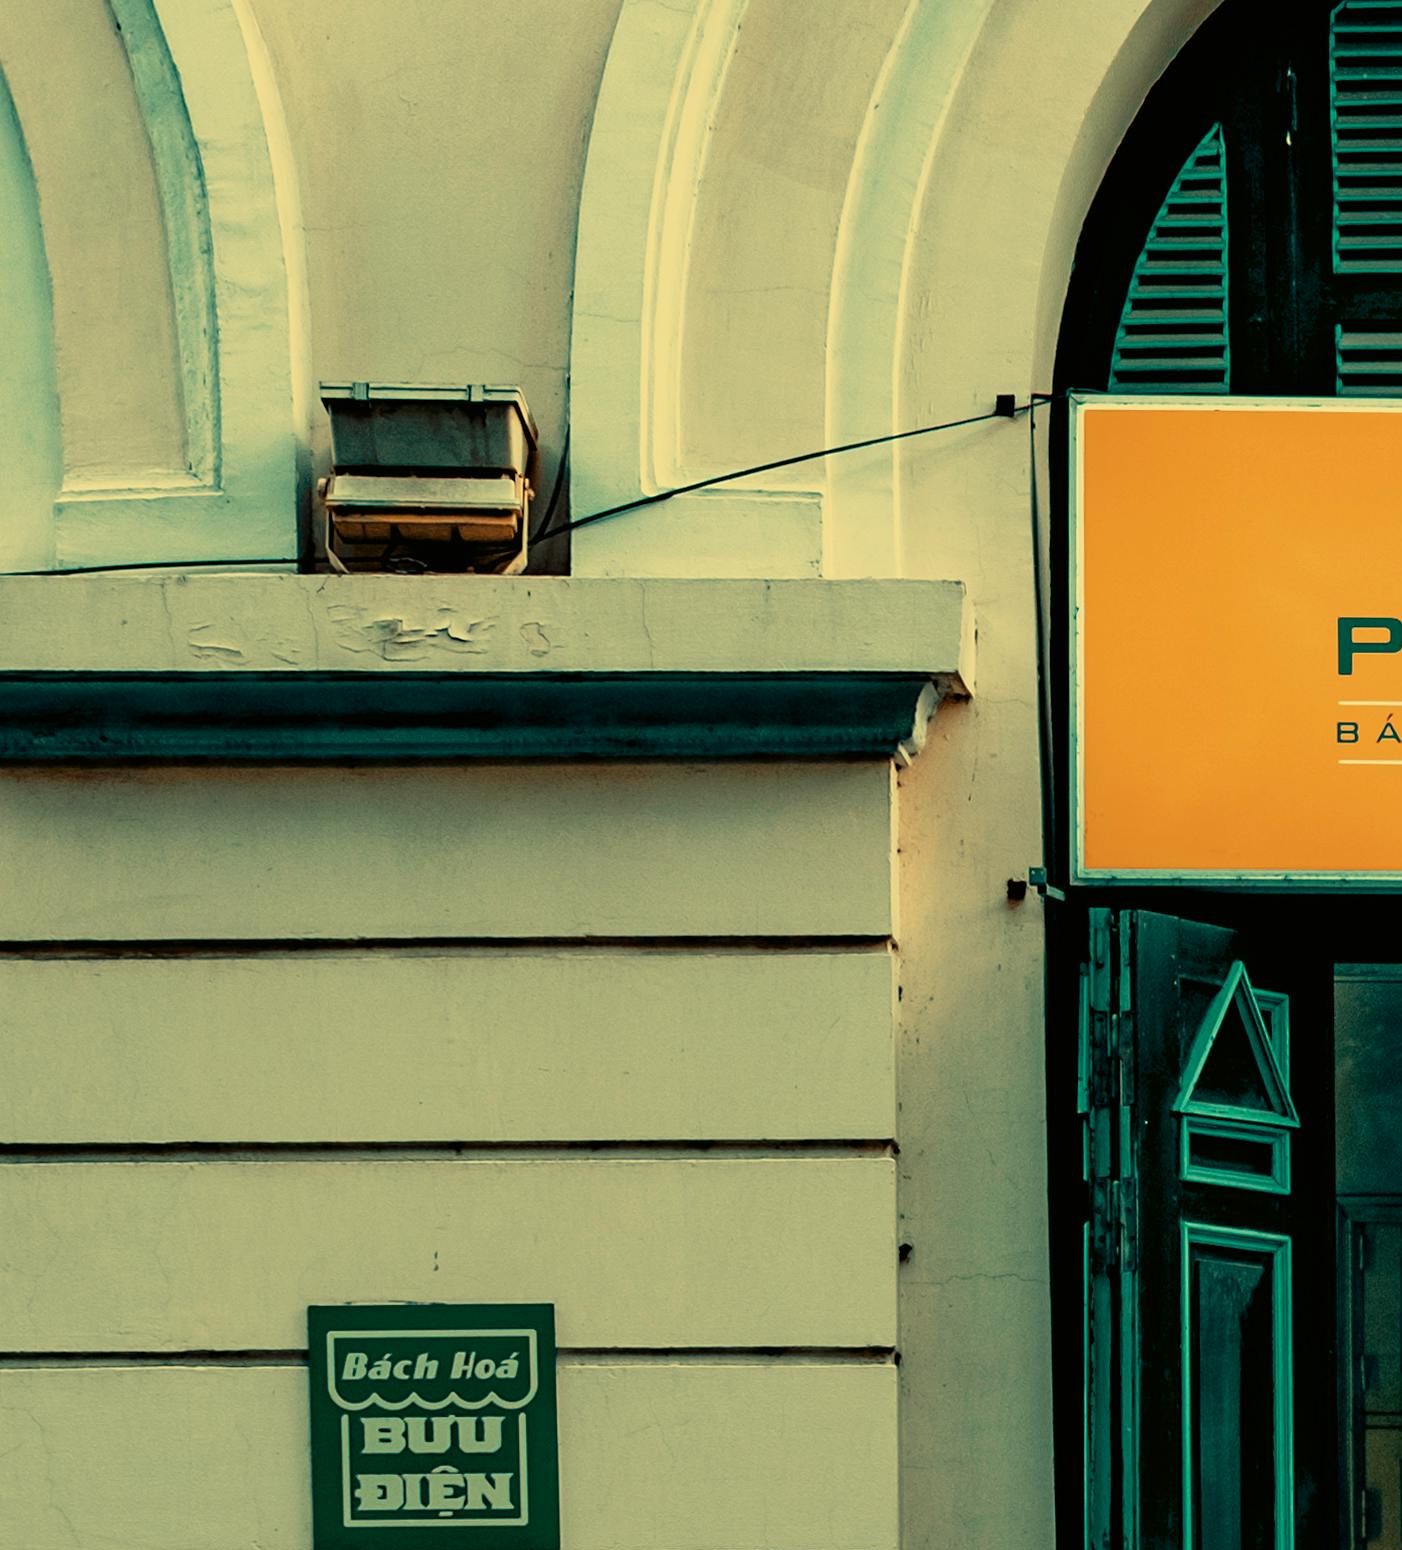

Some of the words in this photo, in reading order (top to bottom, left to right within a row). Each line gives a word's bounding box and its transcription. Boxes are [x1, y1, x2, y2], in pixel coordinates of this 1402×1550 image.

[341, 1352, 440, 1380] Bách
[449, 1351, 521, 1380] Hoá
[359, 1414, 507, 1455] BƯU
[354, 1465, 516, 1517] ĐIỆN
